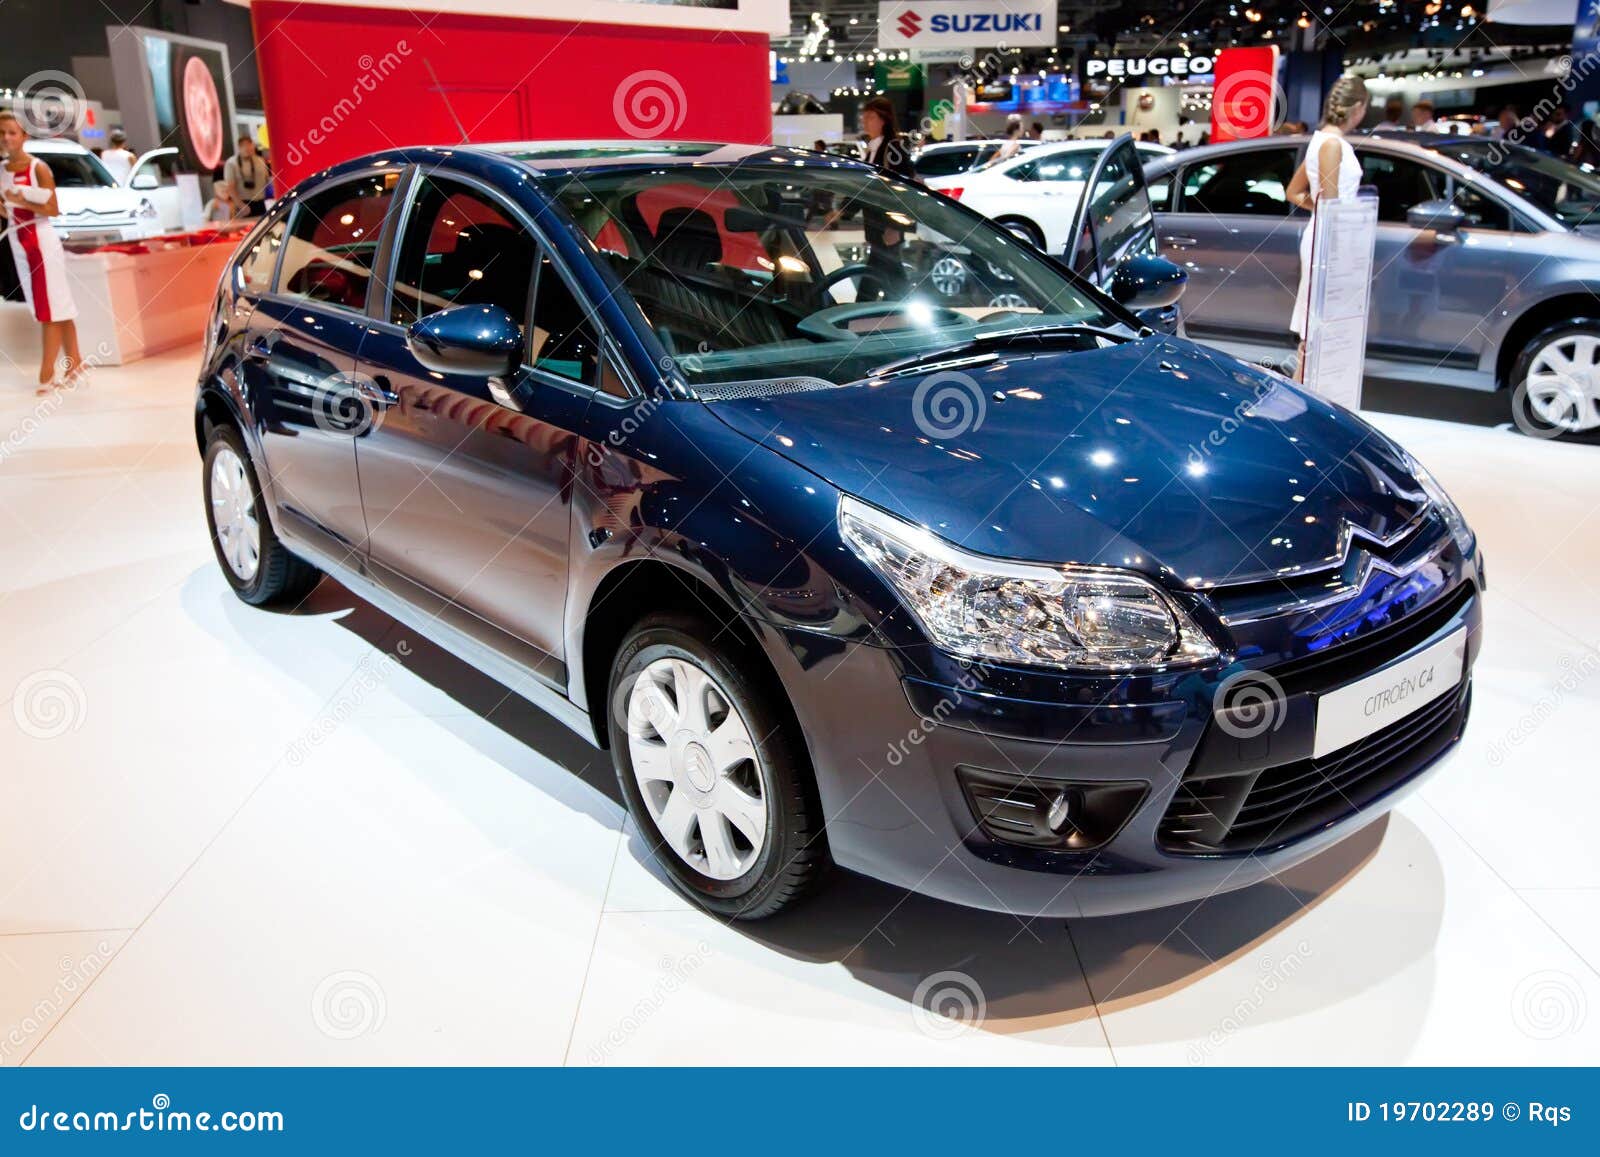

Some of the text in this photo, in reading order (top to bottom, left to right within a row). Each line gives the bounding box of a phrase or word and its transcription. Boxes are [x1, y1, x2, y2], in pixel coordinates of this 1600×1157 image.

[930, 13, 1042, 33] SUZUKI
[1086, 56, 1214, 77] PEUGEO
[1364, 665, 1435, 717] CITROËN C4
